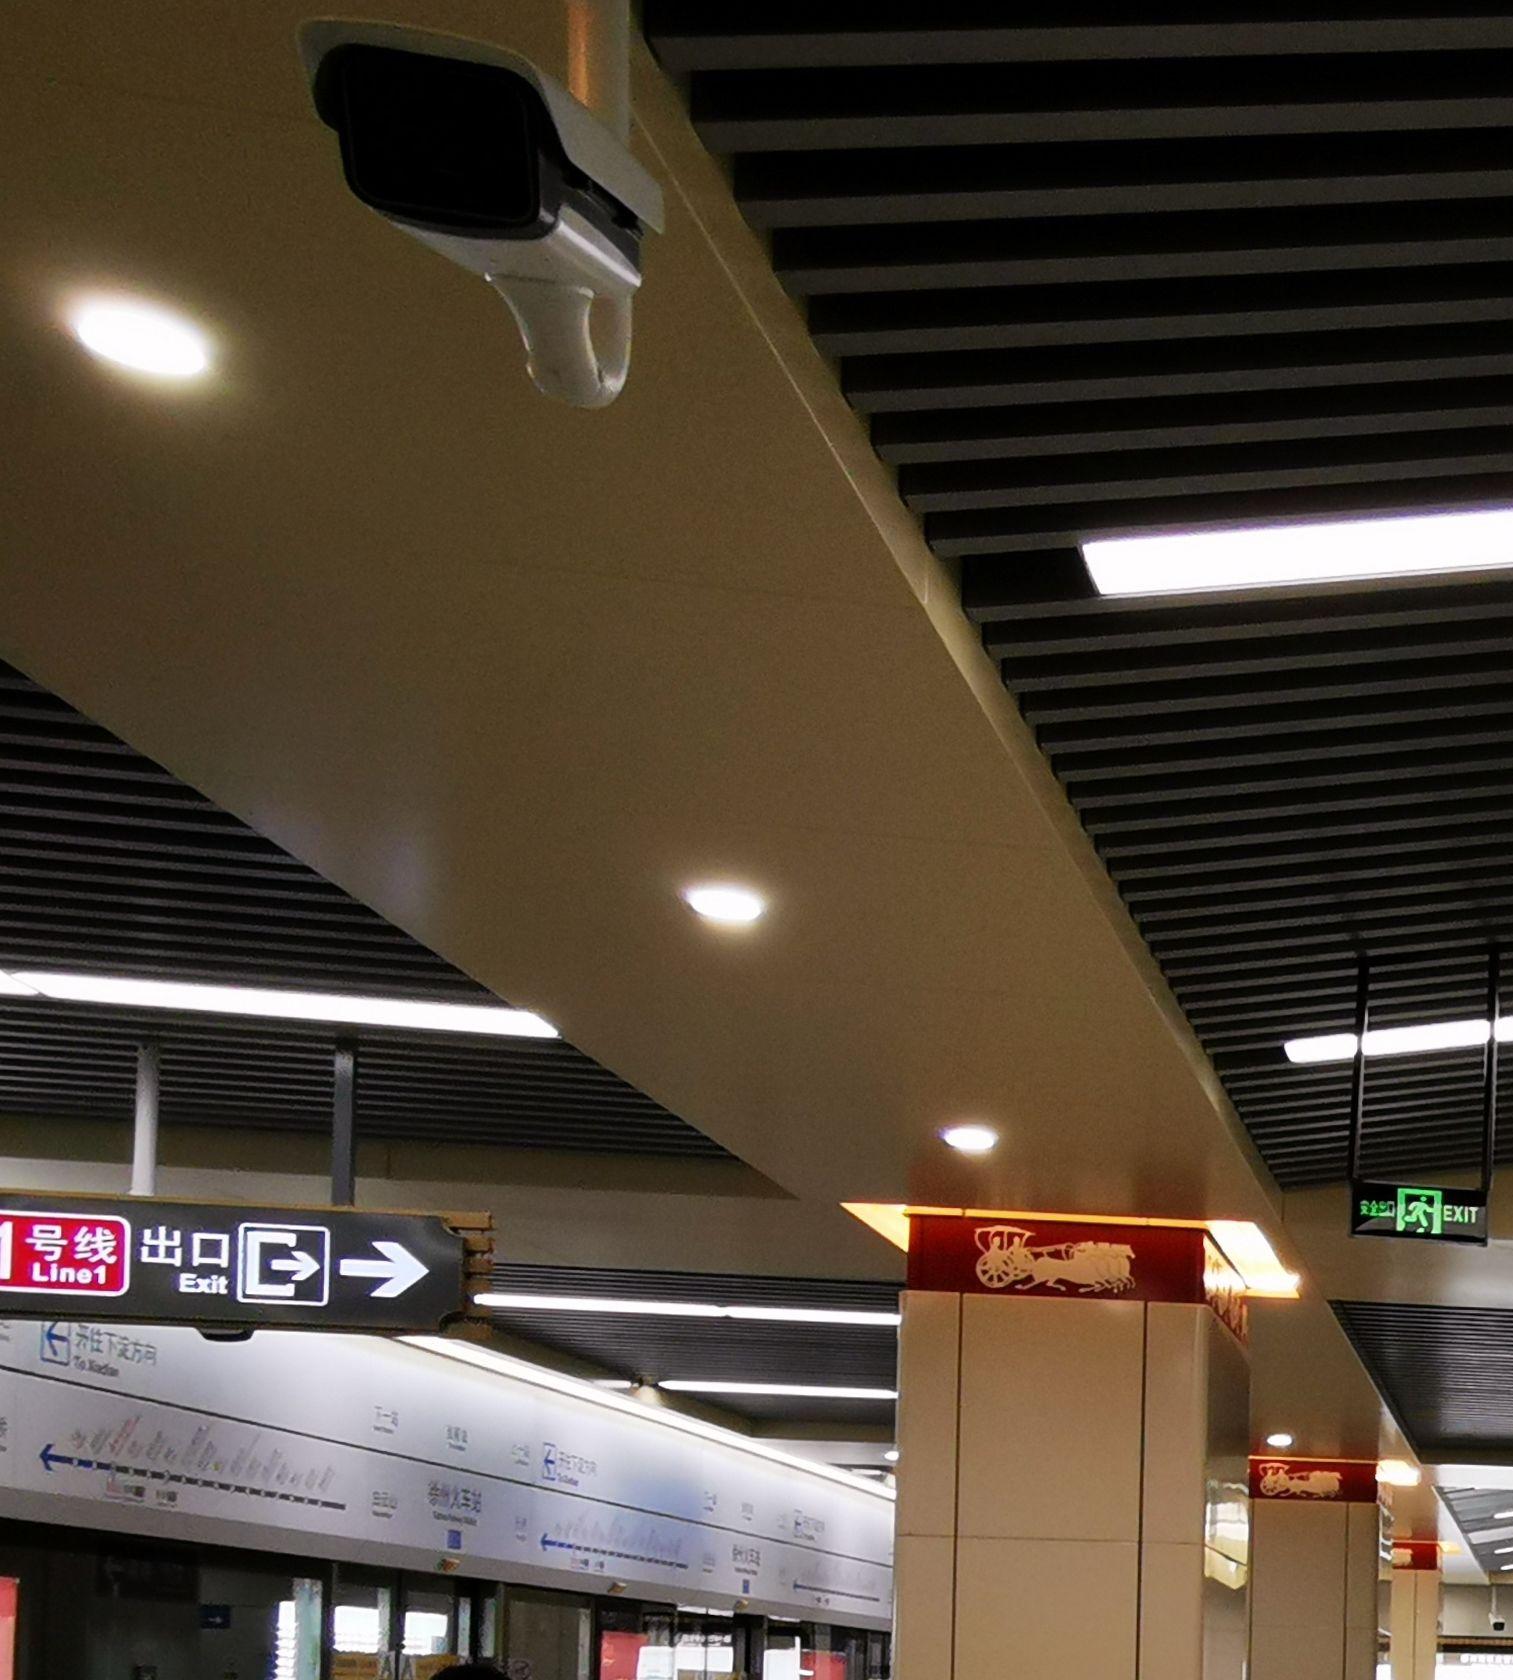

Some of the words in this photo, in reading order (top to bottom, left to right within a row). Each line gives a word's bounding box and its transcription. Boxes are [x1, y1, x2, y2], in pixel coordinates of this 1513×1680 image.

[1443, 1204, 1480, 1224] EXIT
[140, 1225, 231, 1269] 出口
[32, 1261, 107, 1285] Line1
[178, 1272, 230, 1294] Exit
